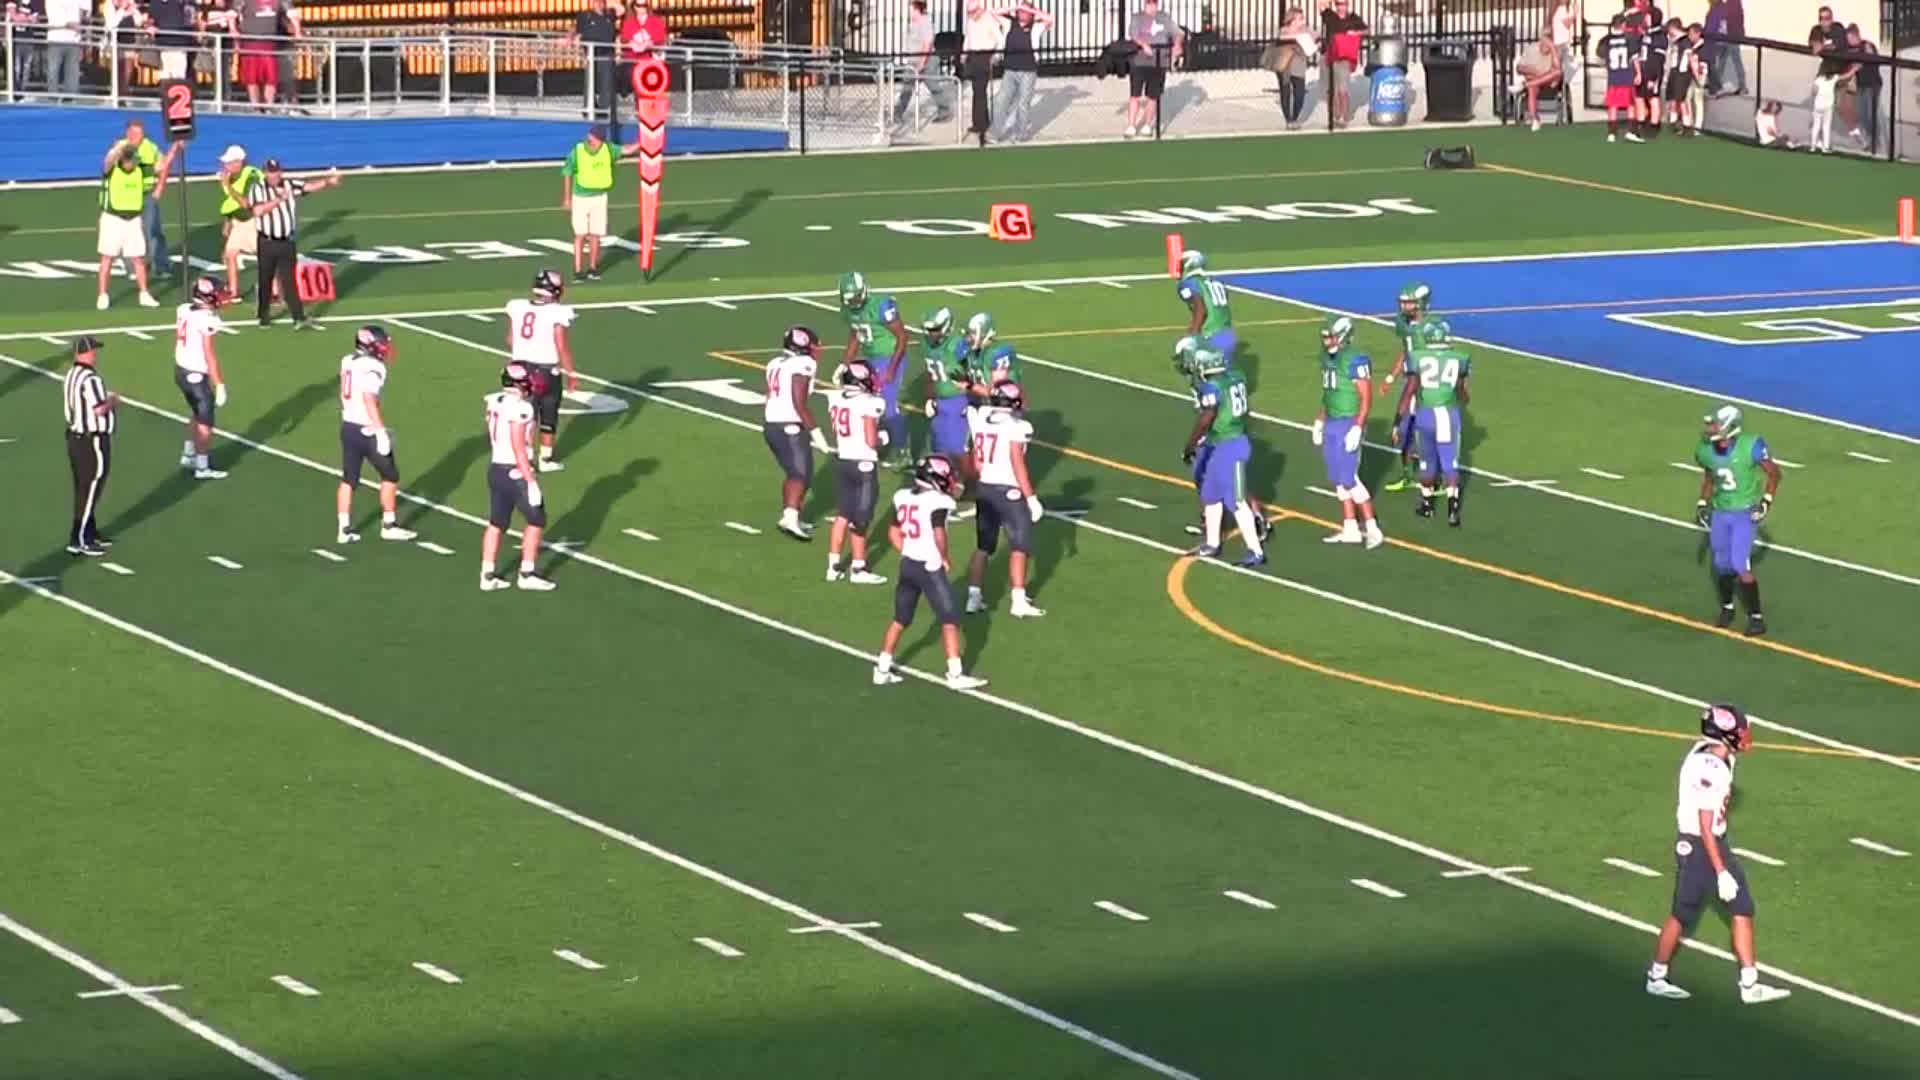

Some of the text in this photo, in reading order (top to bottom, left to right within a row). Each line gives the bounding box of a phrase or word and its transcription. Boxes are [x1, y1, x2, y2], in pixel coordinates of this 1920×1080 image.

[167, 84, 193, 119] 2
[999, 208, 1028, 237] G
[1056, 197, 1440, 229] JOHN
[301, 265, 331, 298] 10
[520, 311, 542, 339] 8
[1418, 355, 1460, 389] 24
[974, 431, 999, 465] 87
[1717, 467, 1738, 491] 3
